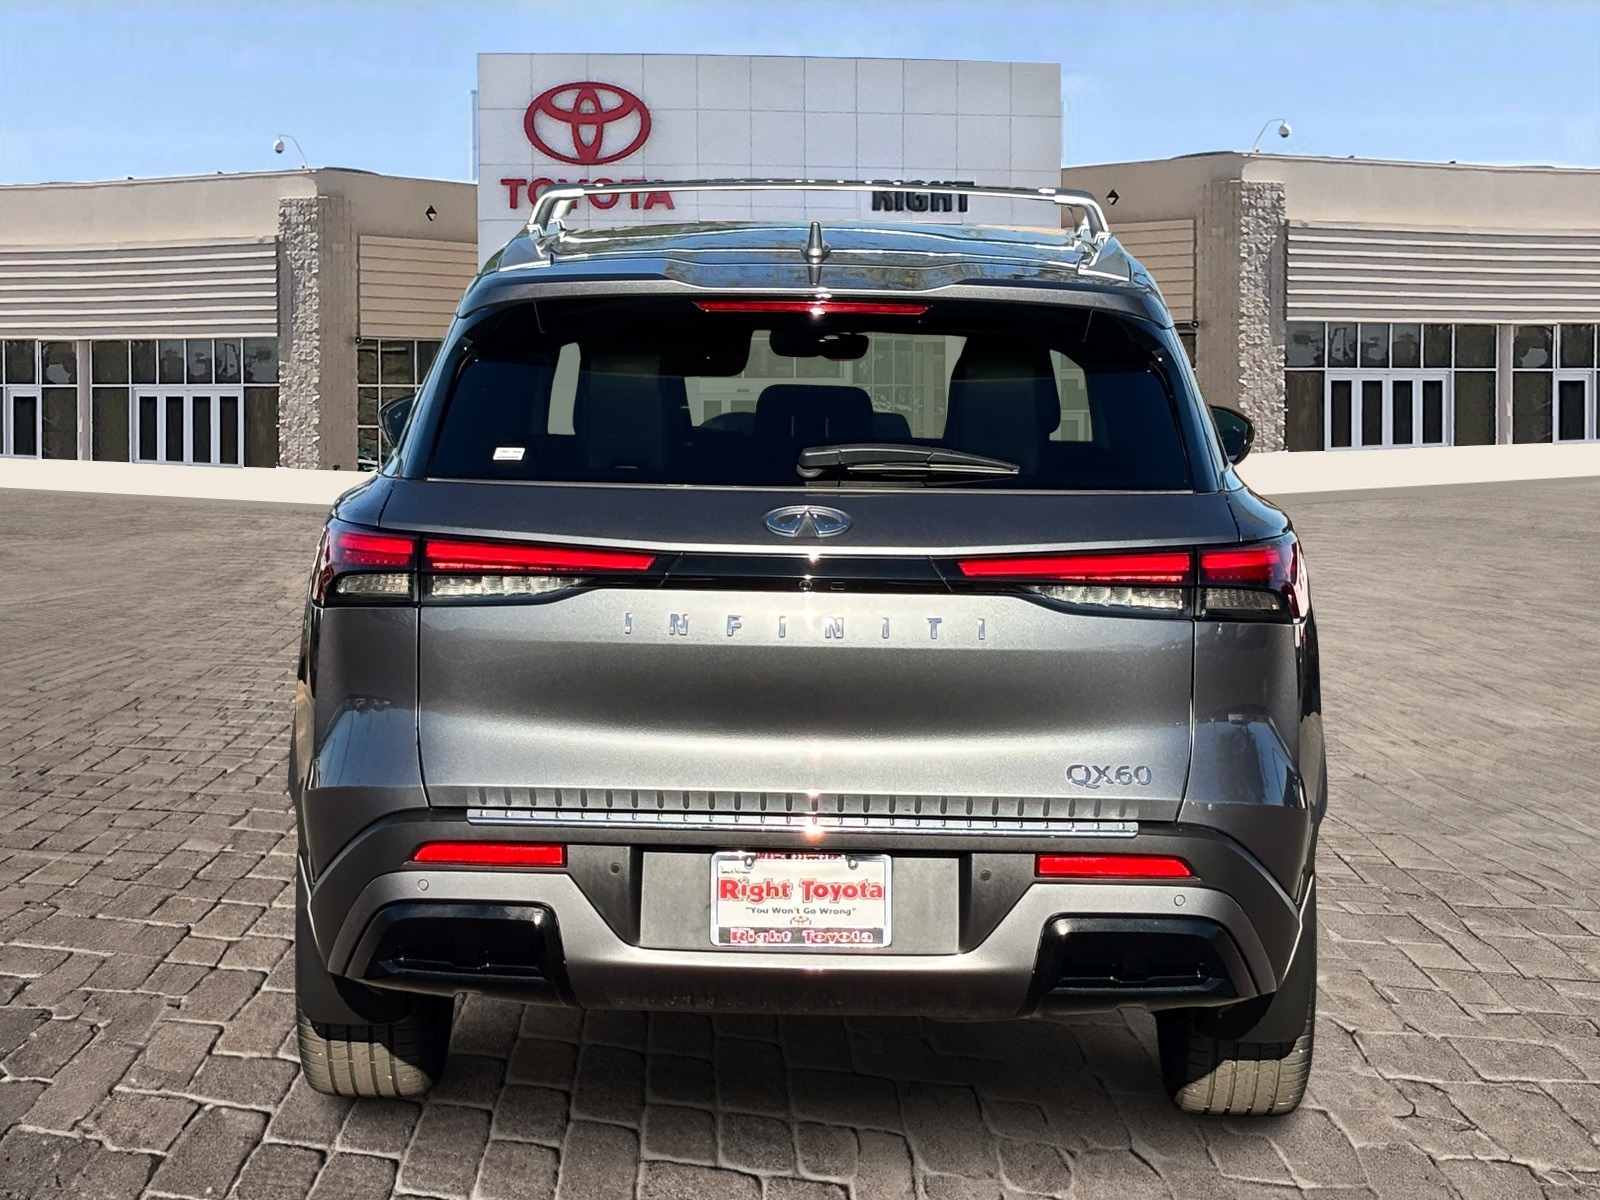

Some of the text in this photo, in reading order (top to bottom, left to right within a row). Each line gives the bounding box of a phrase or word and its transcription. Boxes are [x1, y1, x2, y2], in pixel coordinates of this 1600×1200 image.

[500, 178, 675, 210] TOOTA
[871, 179, 974, 212] RIGHT
[625, 612, 985, 640] INFINITI
[1066, 764, 1152, 789] QX60
[718, 877, 884, 904] Right Toyota
[803, 907, 816, 915] Go
[730, 928, 873, 944] Right Toyota
